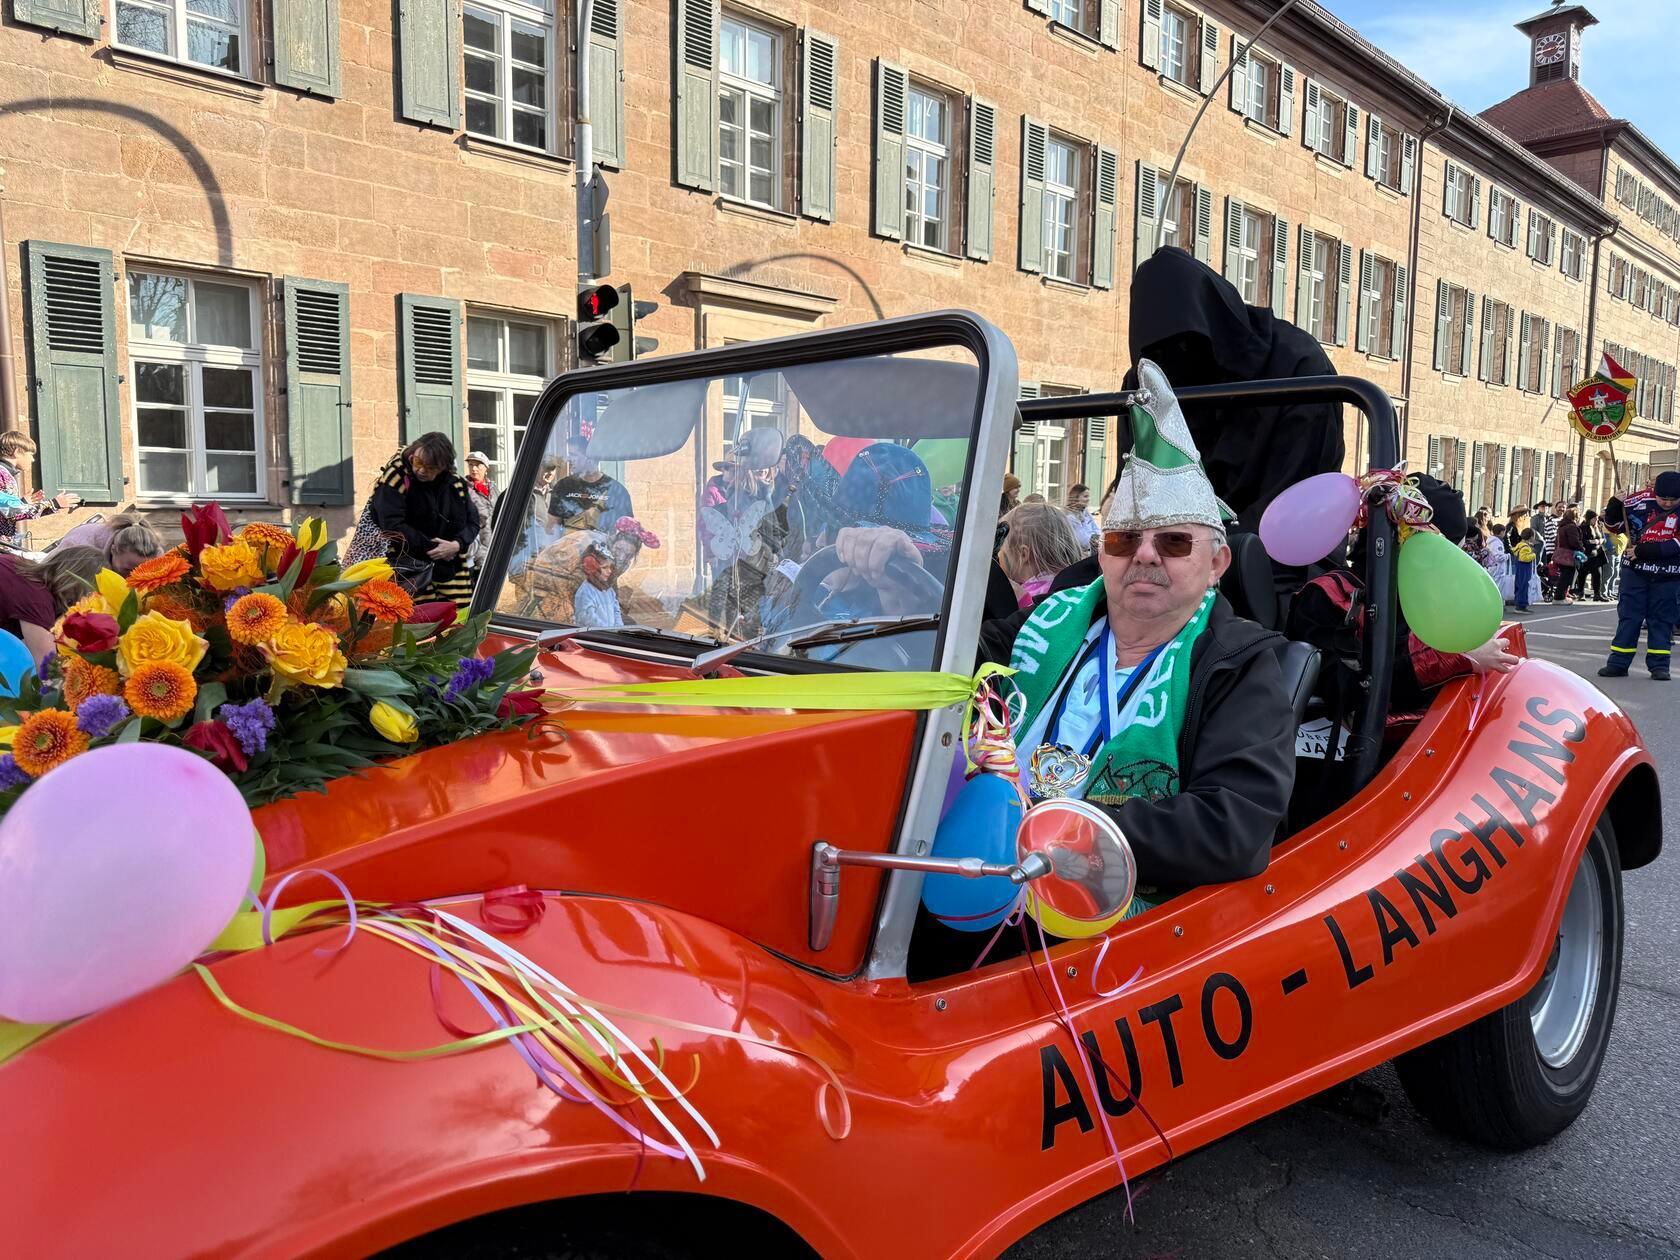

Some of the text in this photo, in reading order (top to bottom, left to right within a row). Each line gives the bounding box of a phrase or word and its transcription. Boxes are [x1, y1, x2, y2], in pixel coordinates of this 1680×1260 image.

[1585, 430, 1623, 441] BLASMUSIK
[1642, 562, 1660, 574] lady
[1041, 972, 1253, 1151] AUTO
[1324, 696, 1587, 990] LANGHANS
